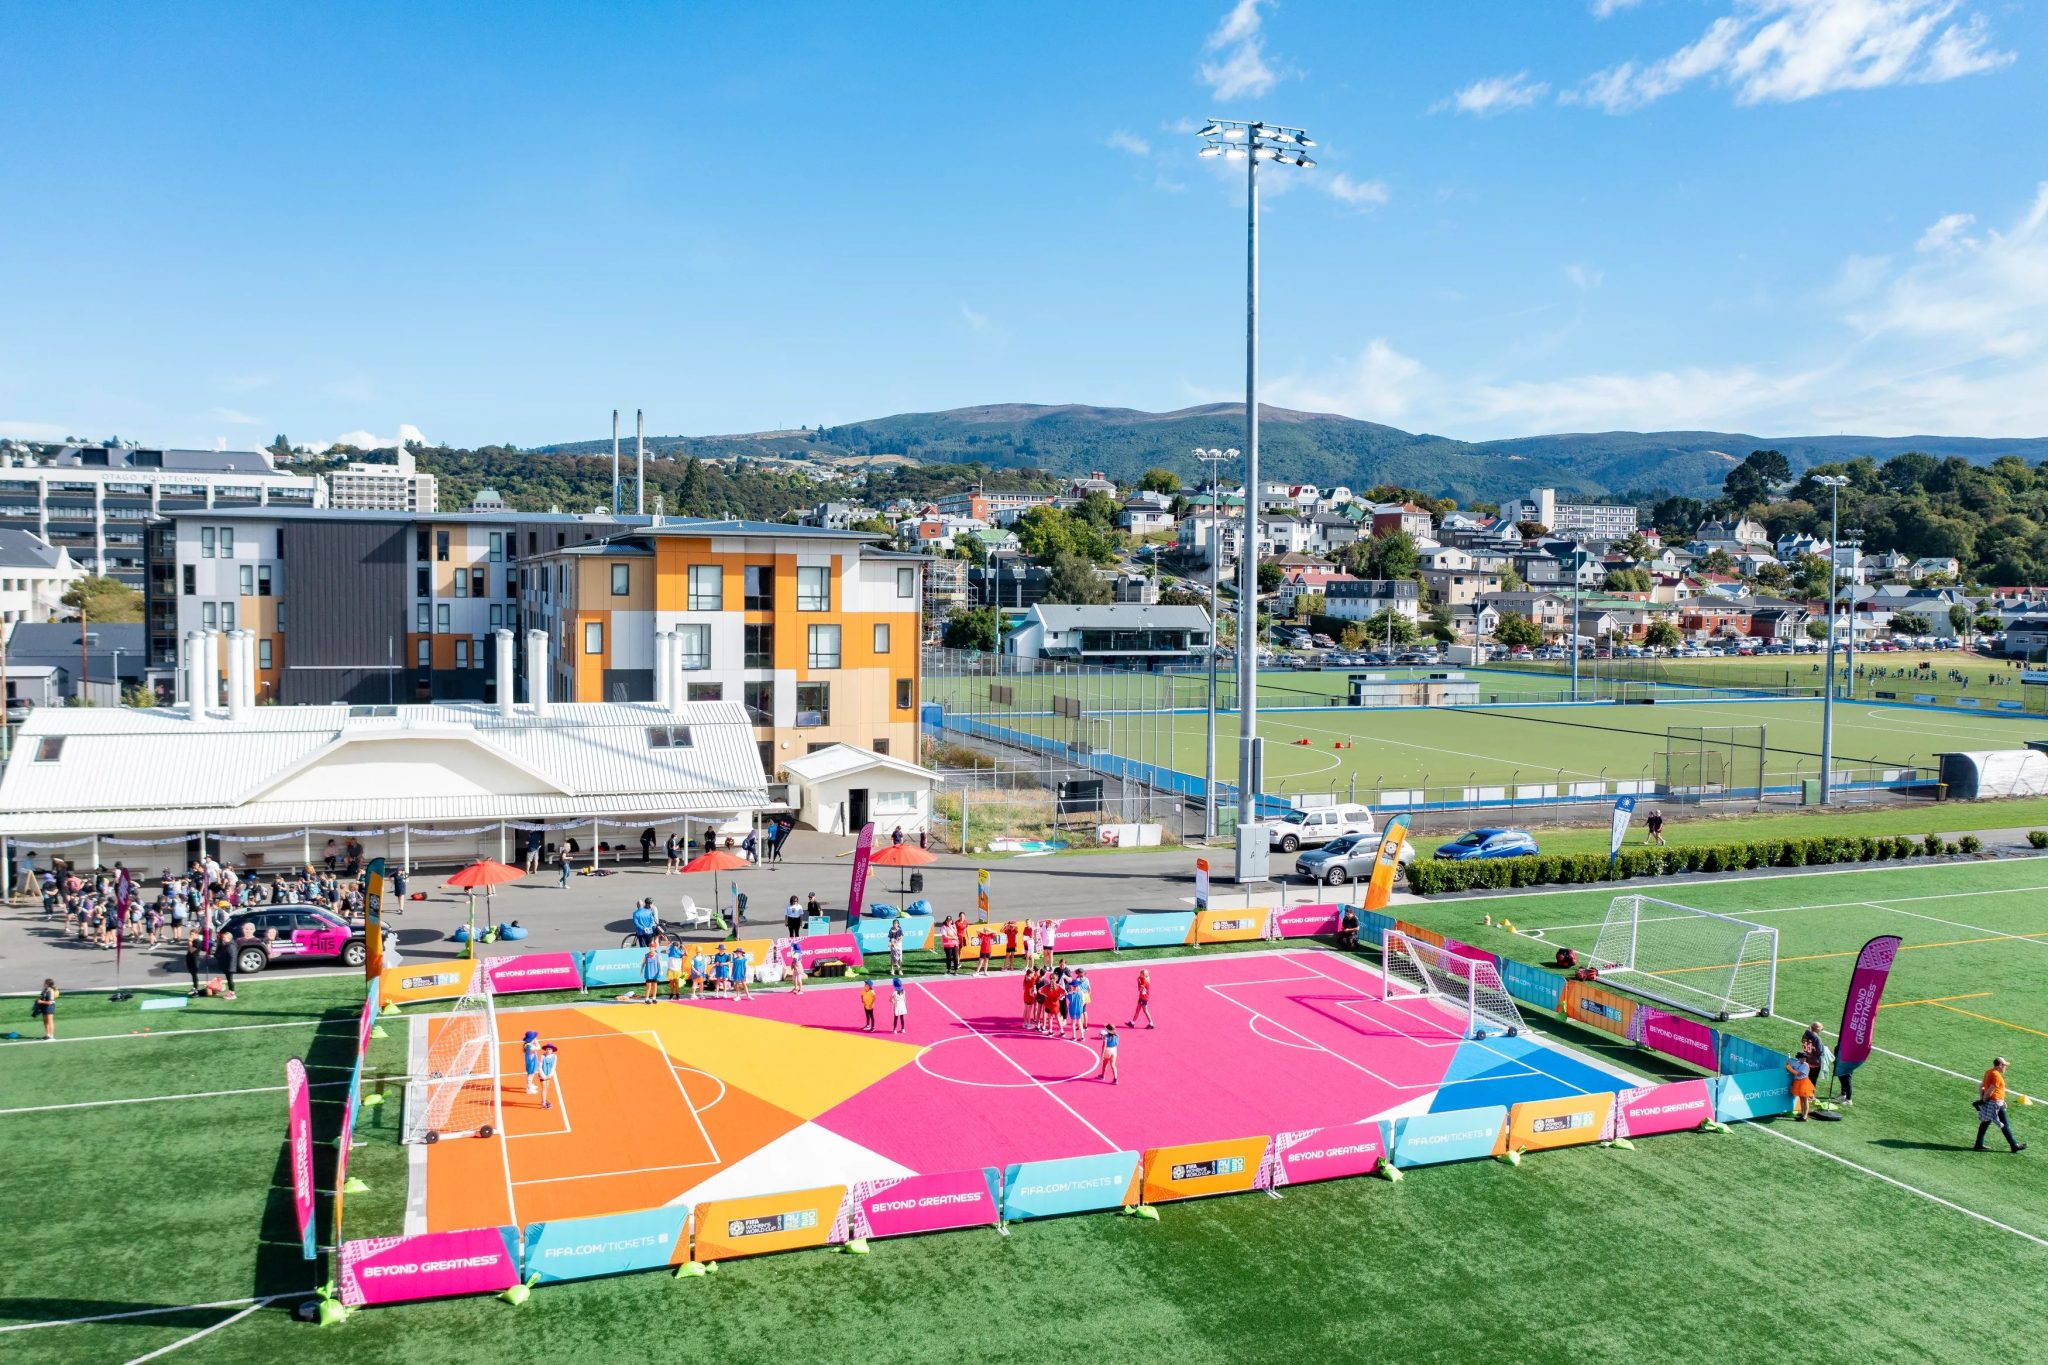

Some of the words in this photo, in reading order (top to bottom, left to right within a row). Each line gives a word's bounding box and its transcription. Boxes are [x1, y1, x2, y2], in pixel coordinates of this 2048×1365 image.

[143, 474, 212, 484] POLYTECHNIC
[1071, 929, 1106, 937] GREATNESS
[814, 946, 853, 955] GREATNESS
[495, 969, 525, 979] BEYOND
[527, 966, 570, 976] GREATNESS
[1850, 988, 1866, 1030] BEYOND
[1855, 984, 1876, 1044] GREATNESS
[1649, 1025, 1673, 1038] BEYOND
[1673, 1034, 1708, 1051] GREATNESS
[1630, 1106, 1660, 1117] BEYOND
[1662, 1100, 1705, 1113] GREATNESS
[1408, 1129, 1483, 1146] FIFA.COM/TICKETS
[1288, 1149, 1324, 1163] BEYOND
[1326, 1142, 1376, 1159] GREATNESS
[1020, 1177, 1112, 1196] FIFA.COM/TICKETS
[872, 1199, 916, 1213] BEYOND
[919, 1193, 981, 1207] GREATNESS
[745, 1222, 772, 1230] WOMEN'S
[745, 1227, 765, 1235] WORLD
[545, 1235, 655, 1258] FIFA.COM/TICKETS
[363, 1262, 419, 1277] BEYOND
[421, 1254, 498, 1273] GREATNESS
